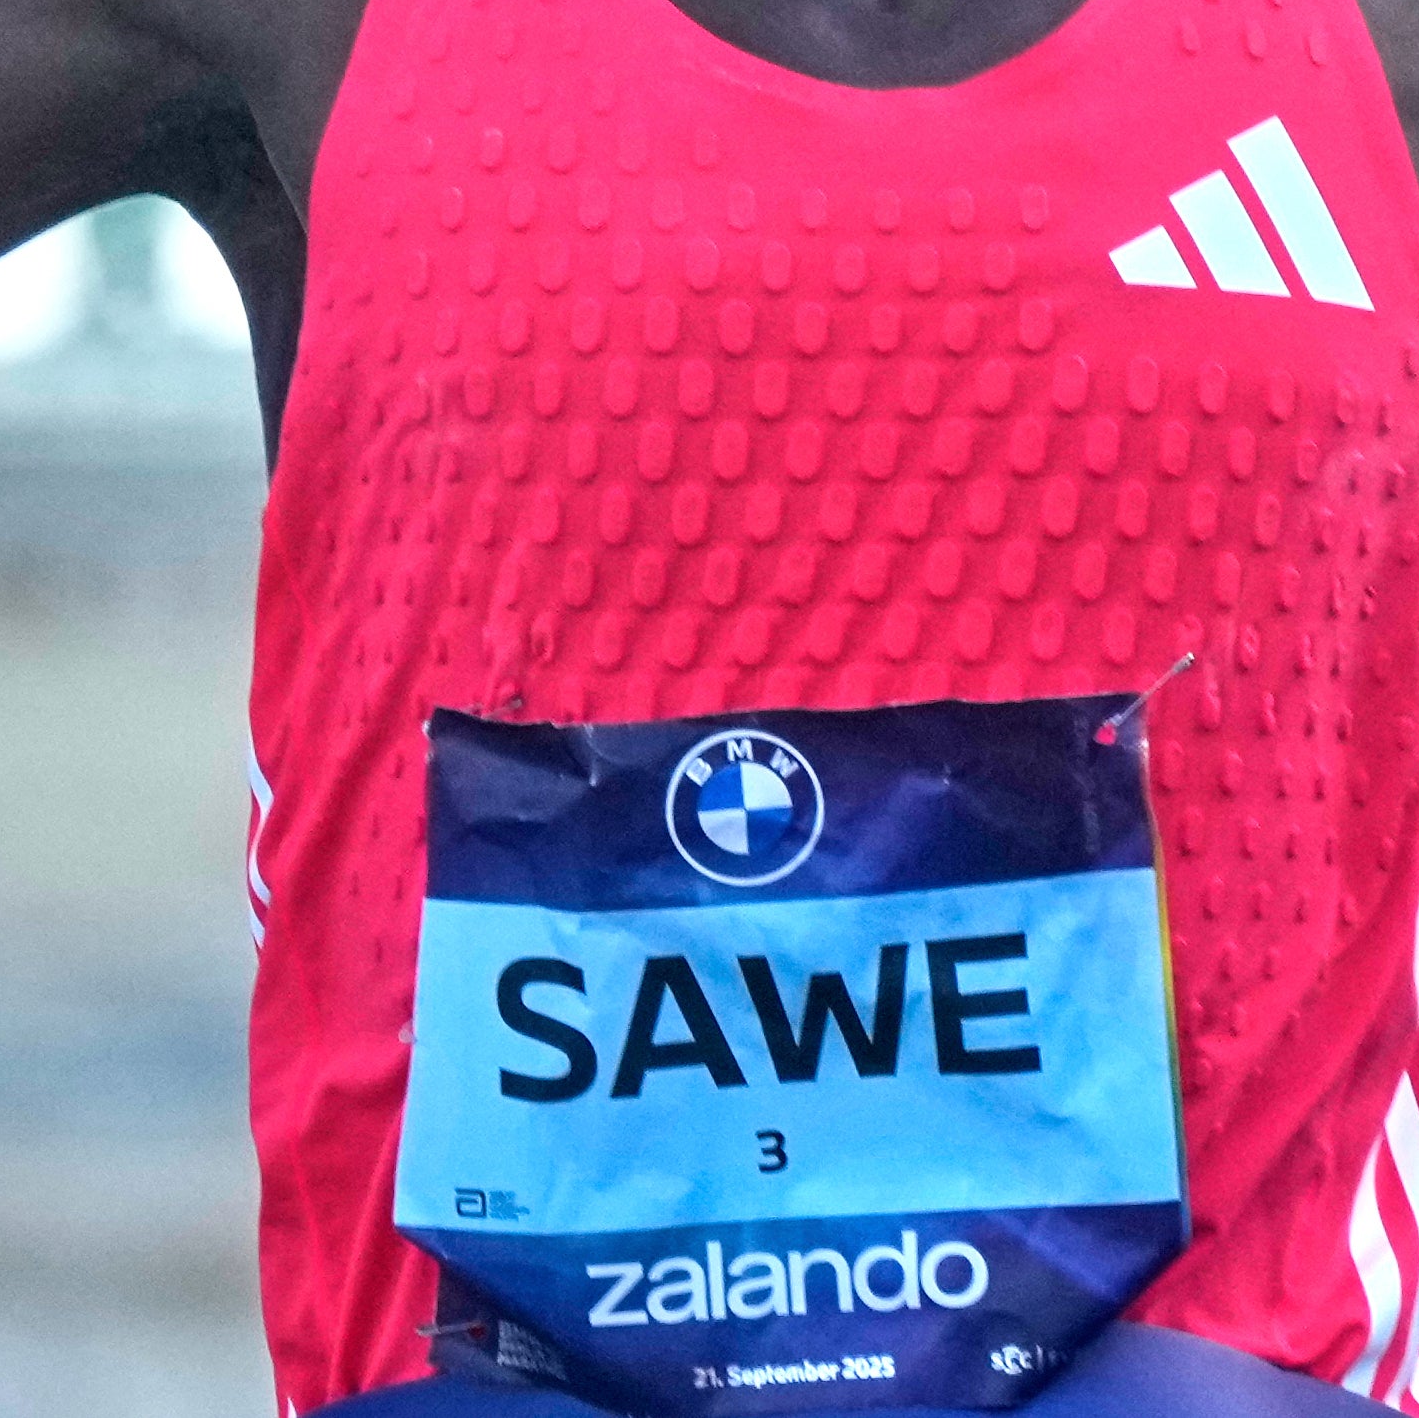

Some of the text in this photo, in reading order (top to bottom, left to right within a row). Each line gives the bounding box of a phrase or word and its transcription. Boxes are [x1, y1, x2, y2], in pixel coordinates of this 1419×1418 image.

[686, 738, 801, 787] BMW
[495, 932, 1042, 1104] SAWE
[755, 1129, 789, 1174] 3
[585, 1229, 990, 1328] zalando
[693, 1354, 896, 1389] 21. September 2025
